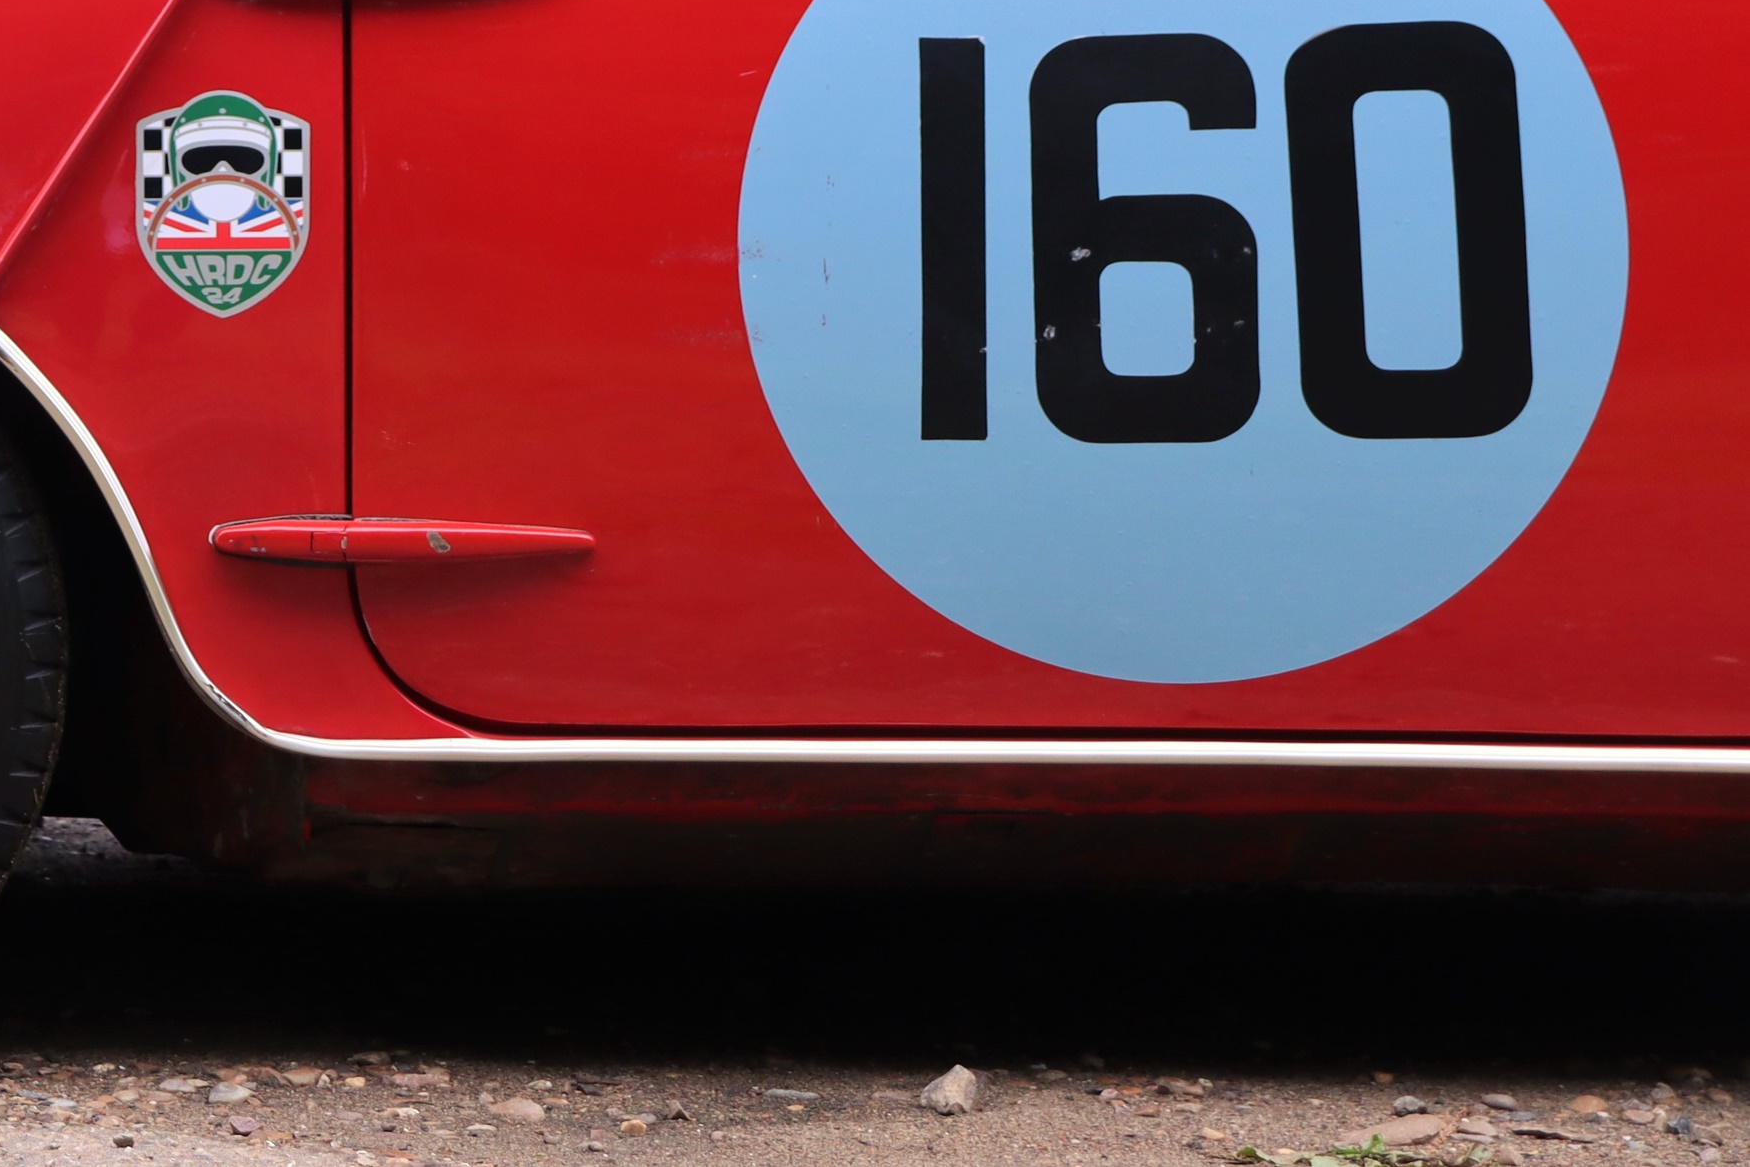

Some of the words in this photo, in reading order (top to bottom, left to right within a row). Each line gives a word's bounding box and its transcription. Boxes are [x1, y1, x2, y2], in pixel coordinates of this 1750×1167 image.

[919, 20, 1533, 443] 160
[162, 254, 282, 286] HRDC
[201, 287, 243, 305] 24
